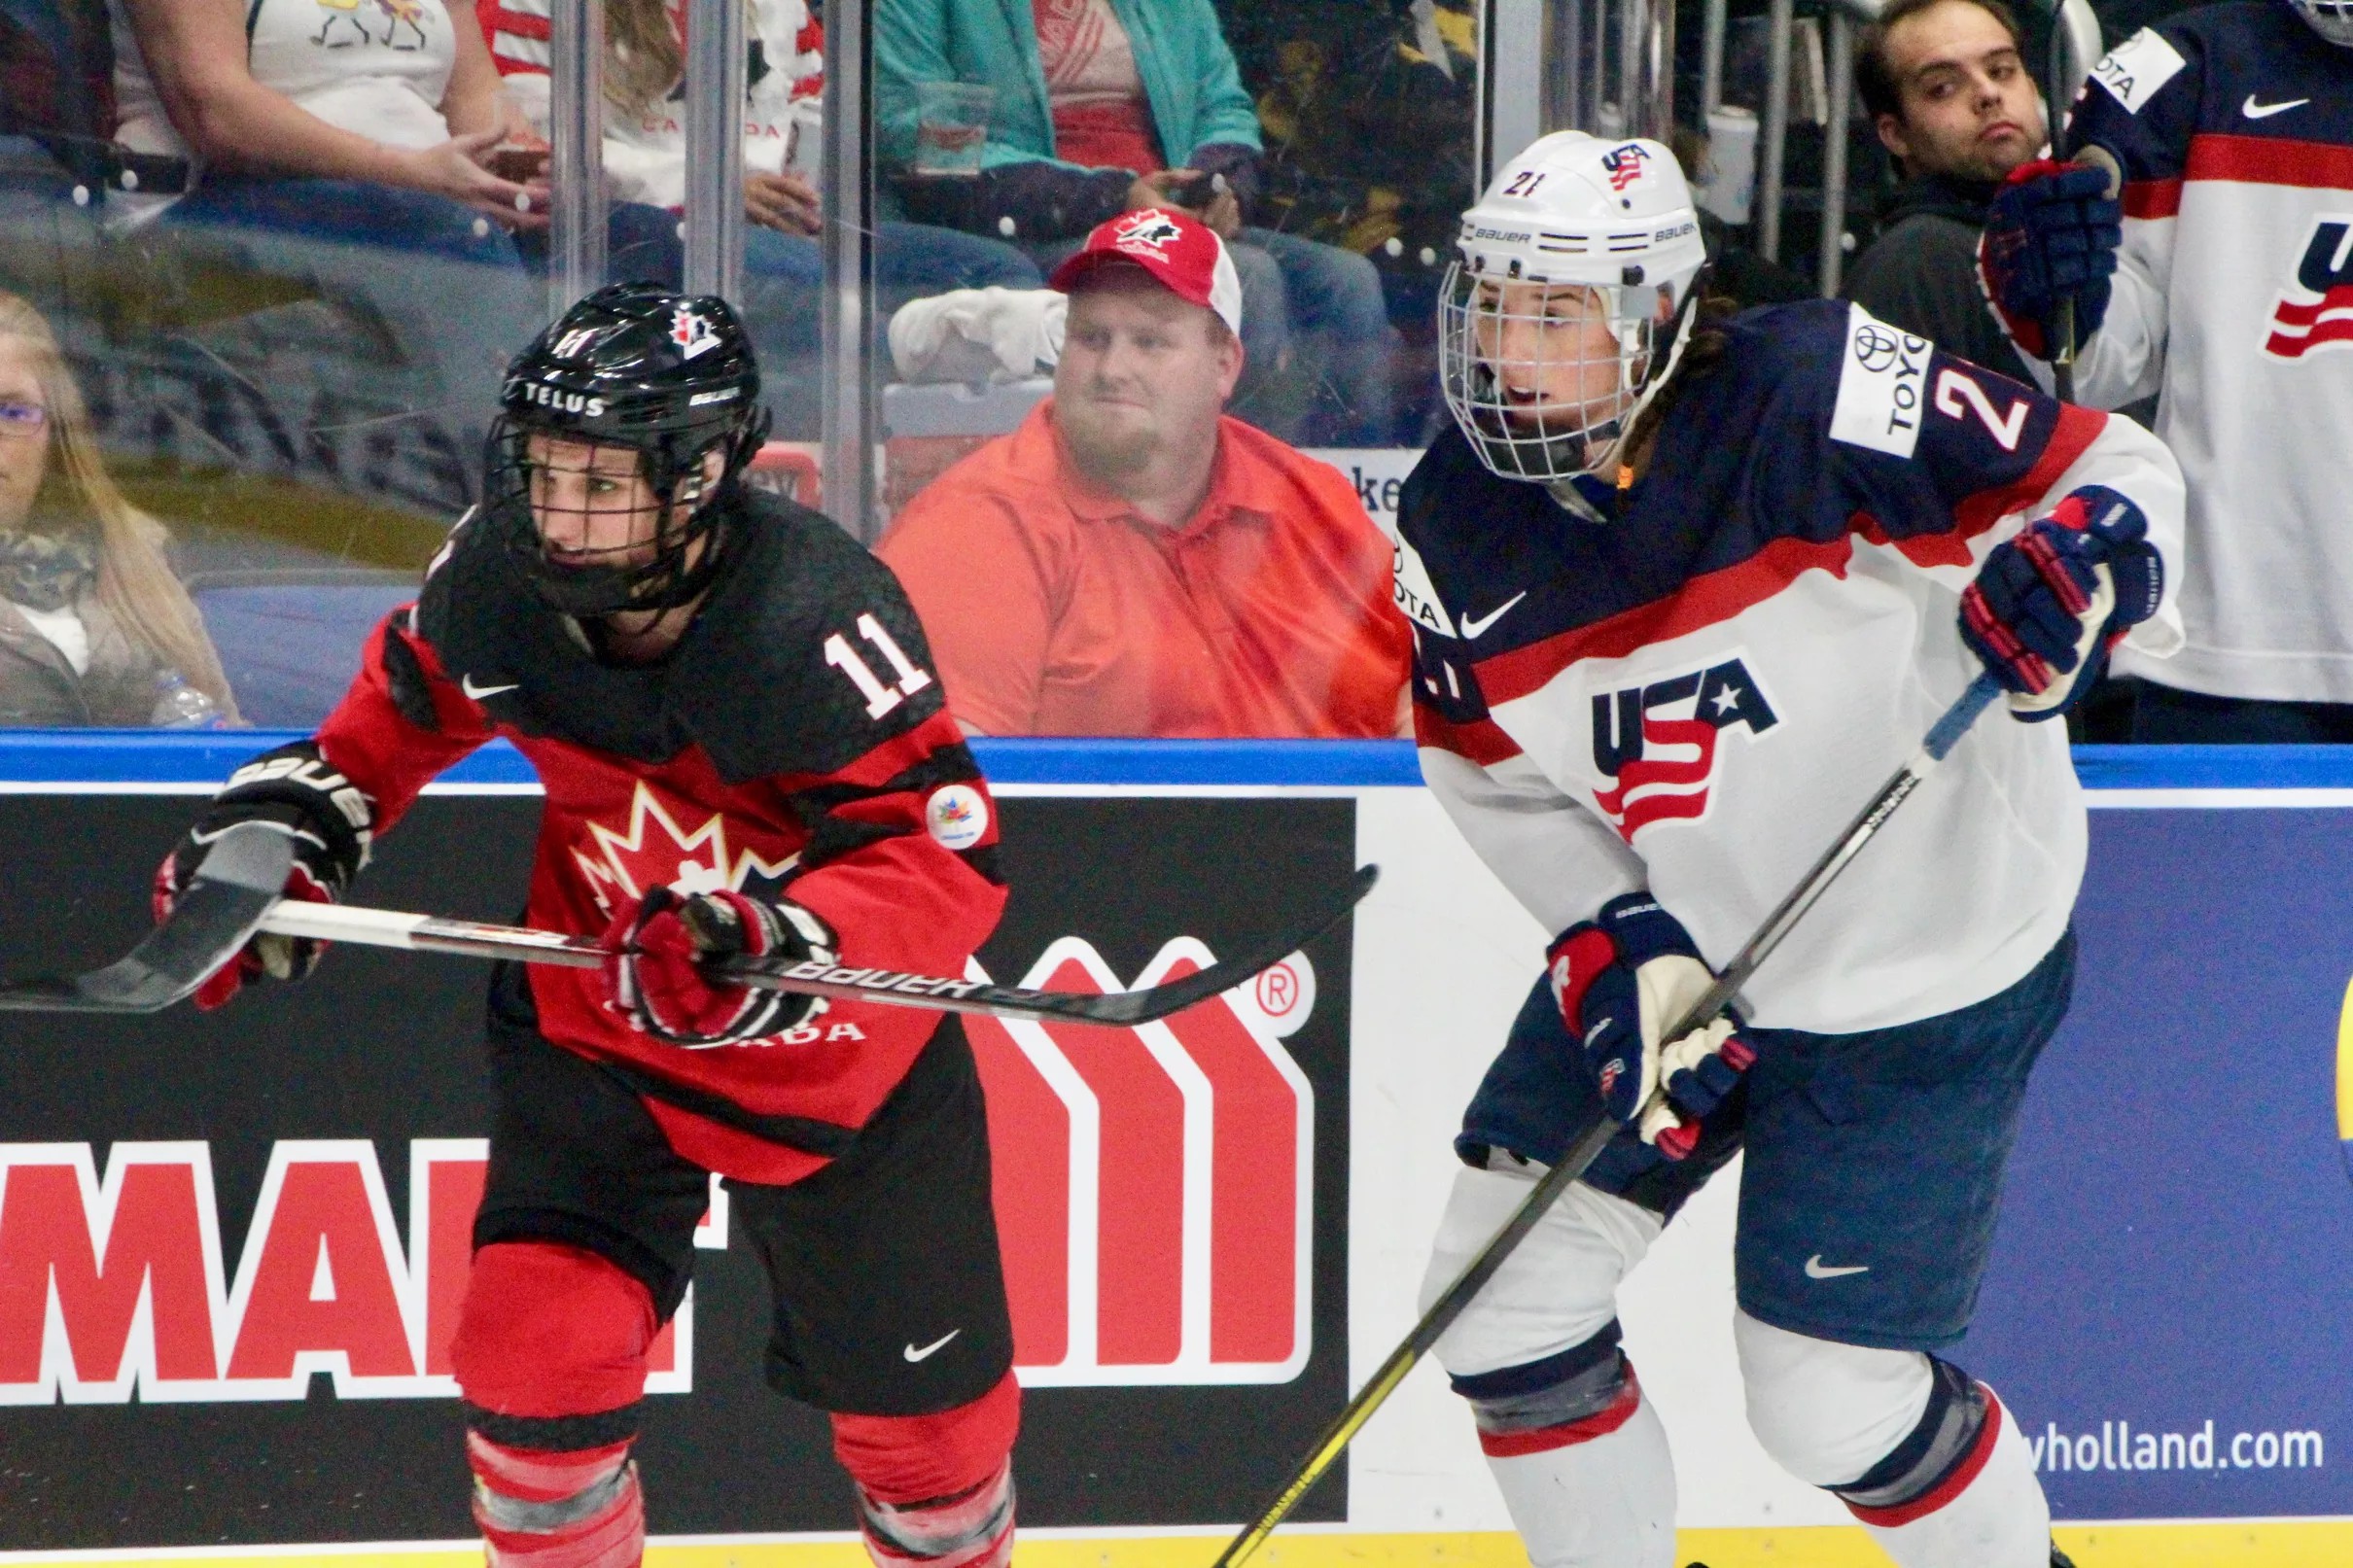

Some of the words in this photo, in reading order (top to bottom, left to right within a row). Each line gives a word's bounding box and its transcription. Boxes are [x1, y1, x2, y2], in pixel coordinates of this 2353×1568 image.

[1503, 171, 1546, 197] 21
[1601, 144, 1651, 192] USA
[1475, 227, 1531, 244] BAUER
[524, 382, 606, 417] TELUS
[824, 611, 933, 720] 11
[1592, 657, 1779, 846] USA
